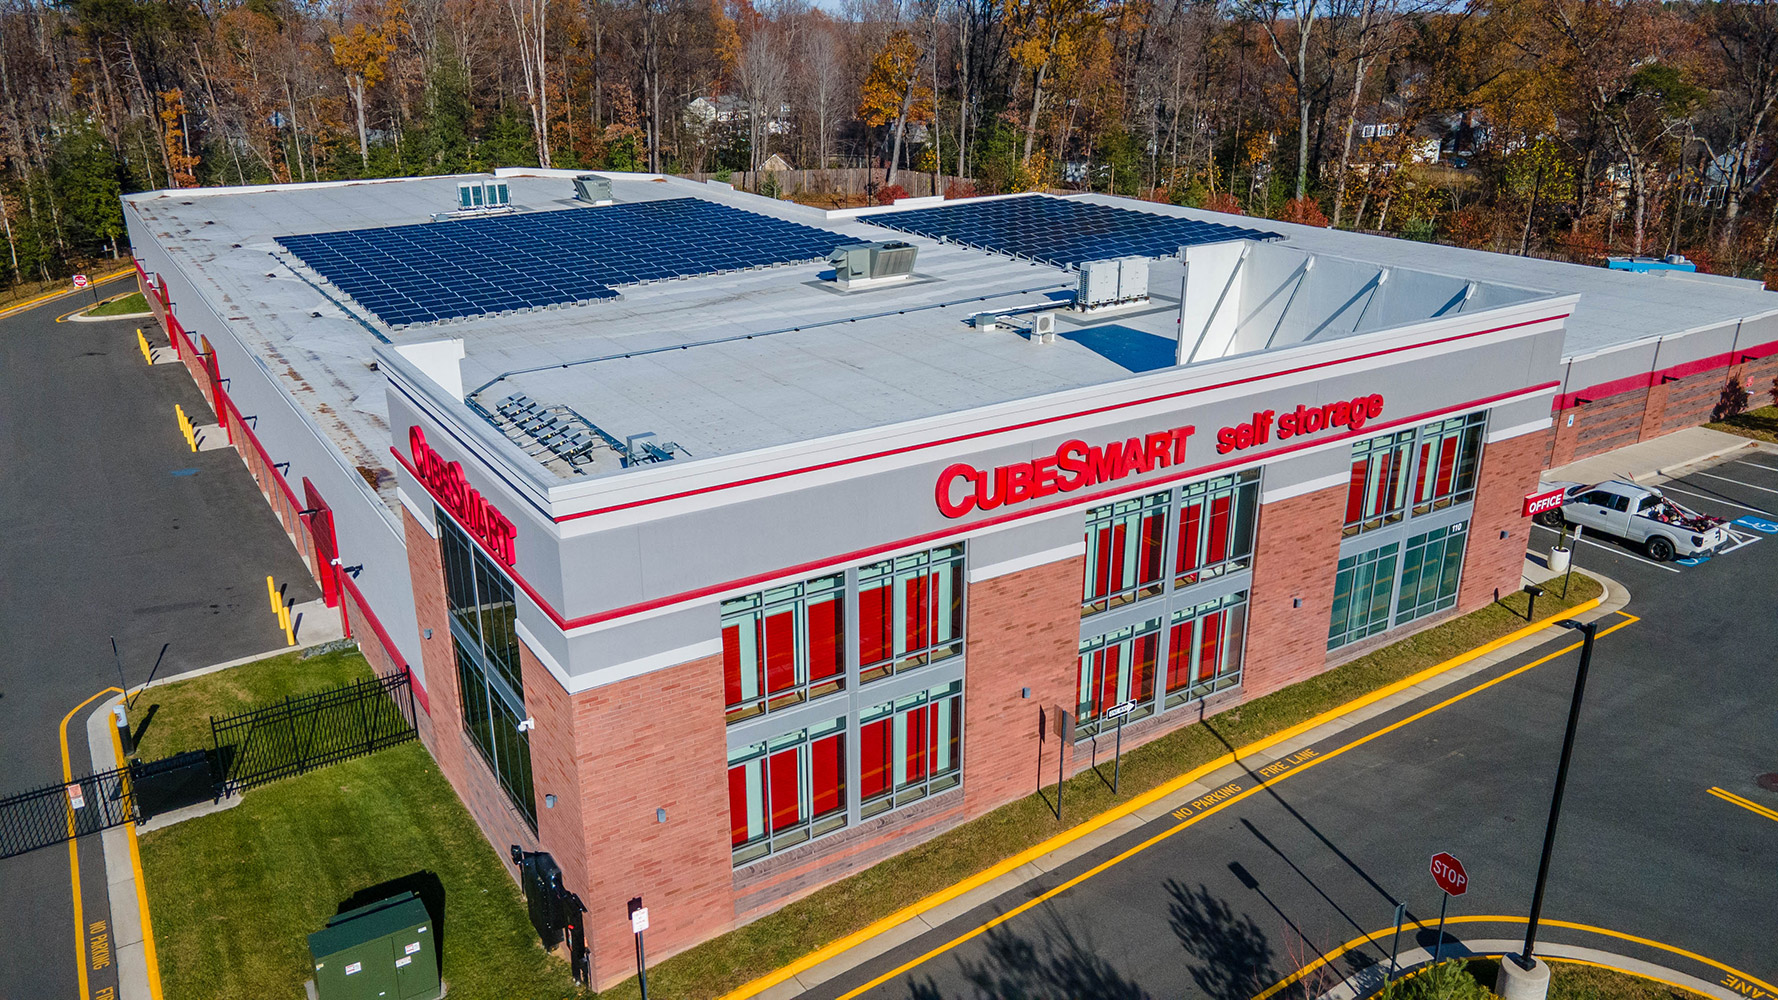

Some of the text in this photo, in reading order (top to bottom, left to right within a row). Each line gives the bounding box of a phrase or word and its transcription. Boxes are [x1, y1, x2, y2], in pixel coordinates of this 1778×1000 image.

[1216, 410, 1275, 454] self
[1277, 393, 1384, 441] storage
[1529, 494, 1562, 513] OFFICE
[1452, 523, 1462, 532] 110
[1172, 748, 1319, 820] NO PARKING FIRE LANE
[1433, 860, 1466, 887] STOP
[89, 920, 107, 934] NO
[90, 933, 110, 970] PARKING
